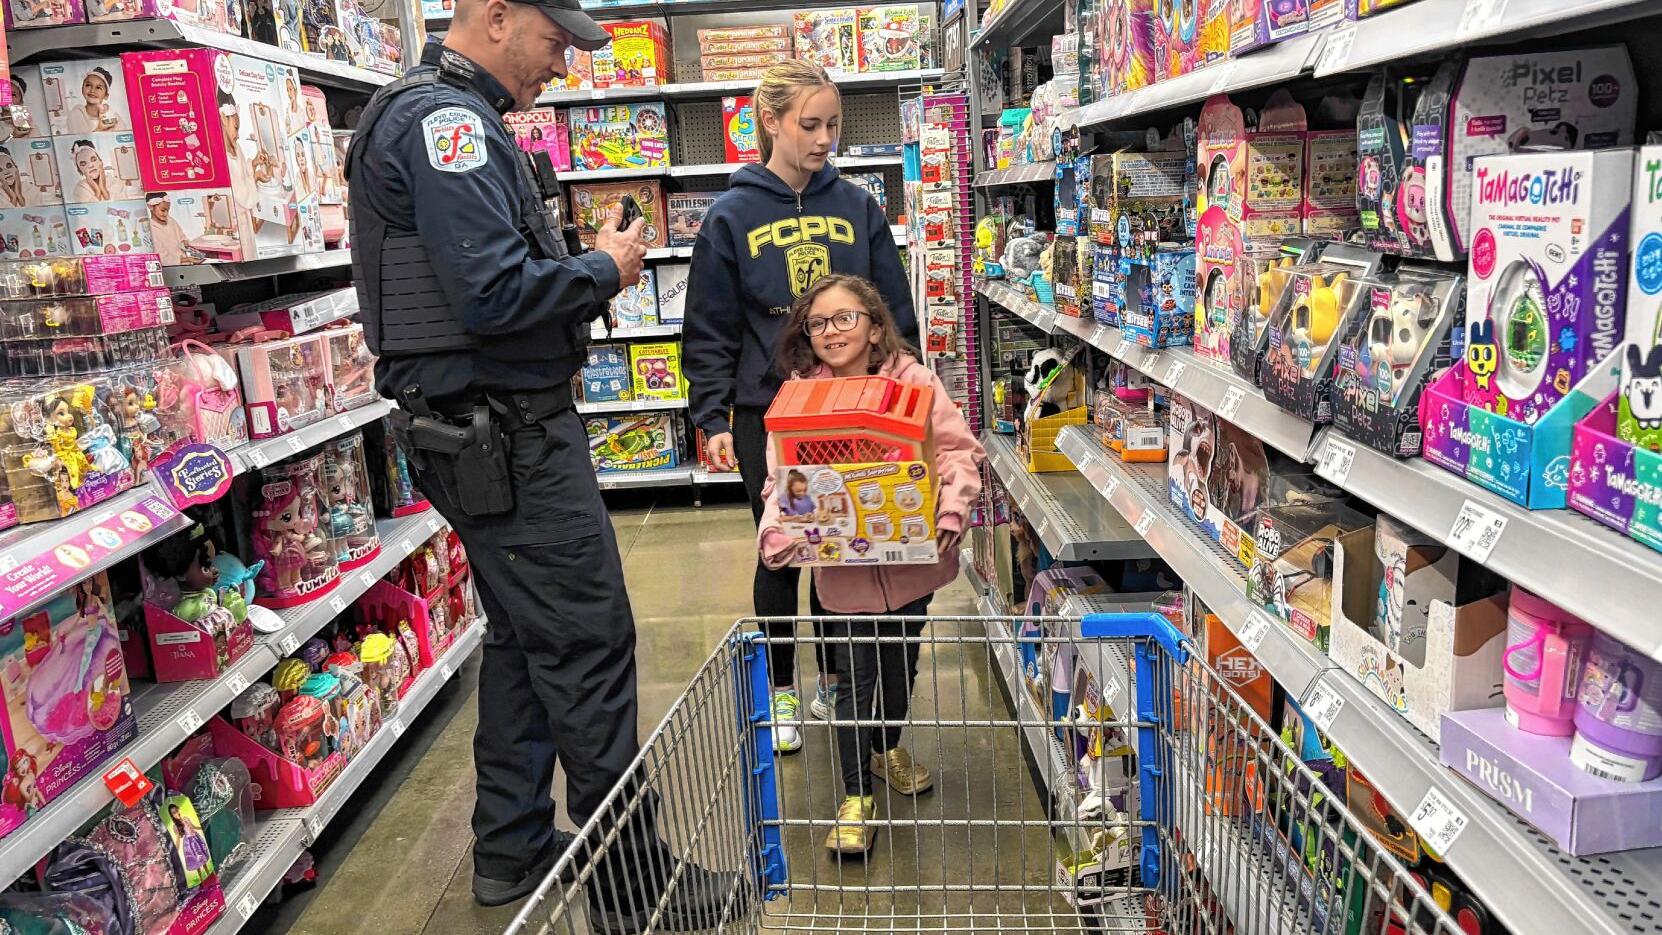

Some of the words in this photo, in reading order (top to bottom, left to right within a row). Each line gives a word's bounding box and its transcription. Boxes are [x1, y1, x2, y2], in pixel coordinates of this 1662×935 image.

[1512, 60, 1582, 87] Pixel
[1523, 87, 1568, 104] Petz
[502, 112, 551, 124] ONOPOLY
[586, 105, 631, 122] LIFE
[738, 106, 755, 135] 5
[746, 215, 856, 259] FCPD
[658, 277, 689, 306] SEQUEN
[1343, 382, 1380, 414] Pixel
[1350, 405, 1374, 431] Petz
[178, 458, 218, 479] Enchanted
[184, 465, 222, 491] Stories
[1257, 538, 1280, 556] ALIVE
[1258, 525, 1281, 544] ROBO
[4, 579, 28, 595] Your
[26, 565, 54, 588] World!
[6, 563, 35, 582] Create
[1223, 670, 1257, 678] BOTS
[45, 763, 81, 795] PRINCESS
[51, 761, 73, 778] Disney
[1465, 748, 1533, 813] PRiSM
[185, 898, 219, 933] PRINCESS
